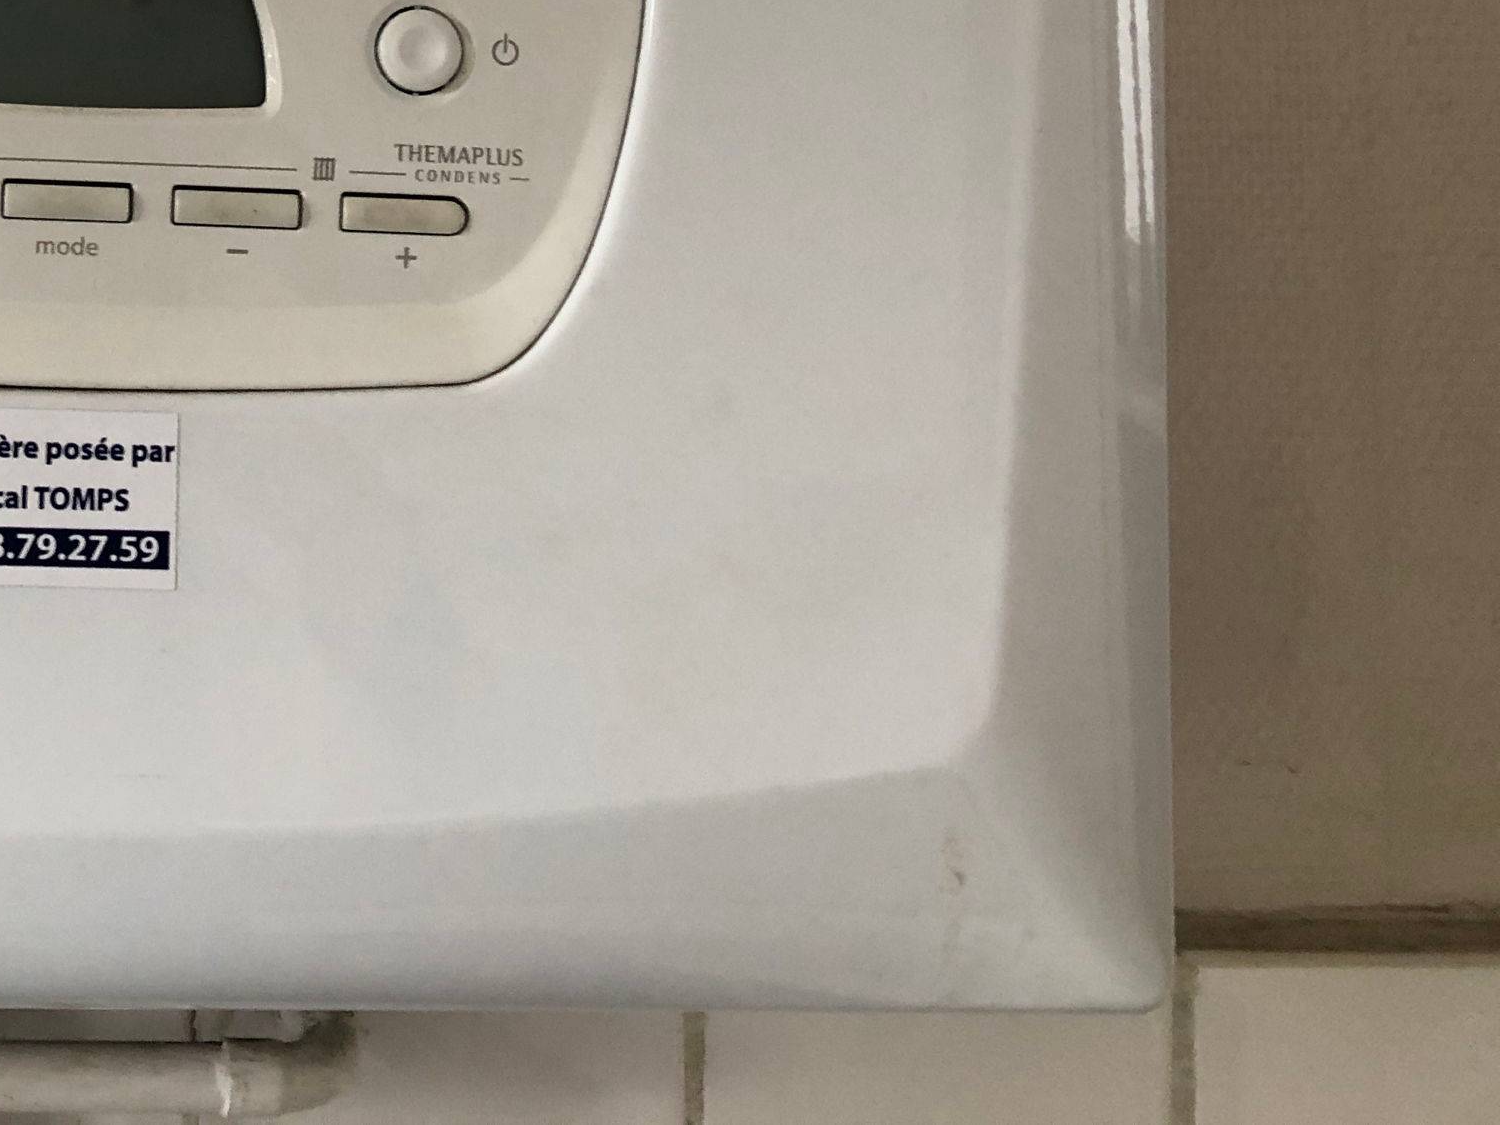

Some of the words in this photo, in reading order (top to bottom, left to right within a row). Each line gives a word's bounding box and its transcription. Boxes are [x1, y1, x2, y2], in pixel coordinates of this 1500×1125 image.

[394, 144, 523, 167] THEMAPLUS
[414, 169, 501, 185] CONDENS
[36, 236, 99, 256] mode
[46, 437, 124, 465] posée
[132, 443, 175, 467] par
[34, 486, 130, 512] TOMPS
